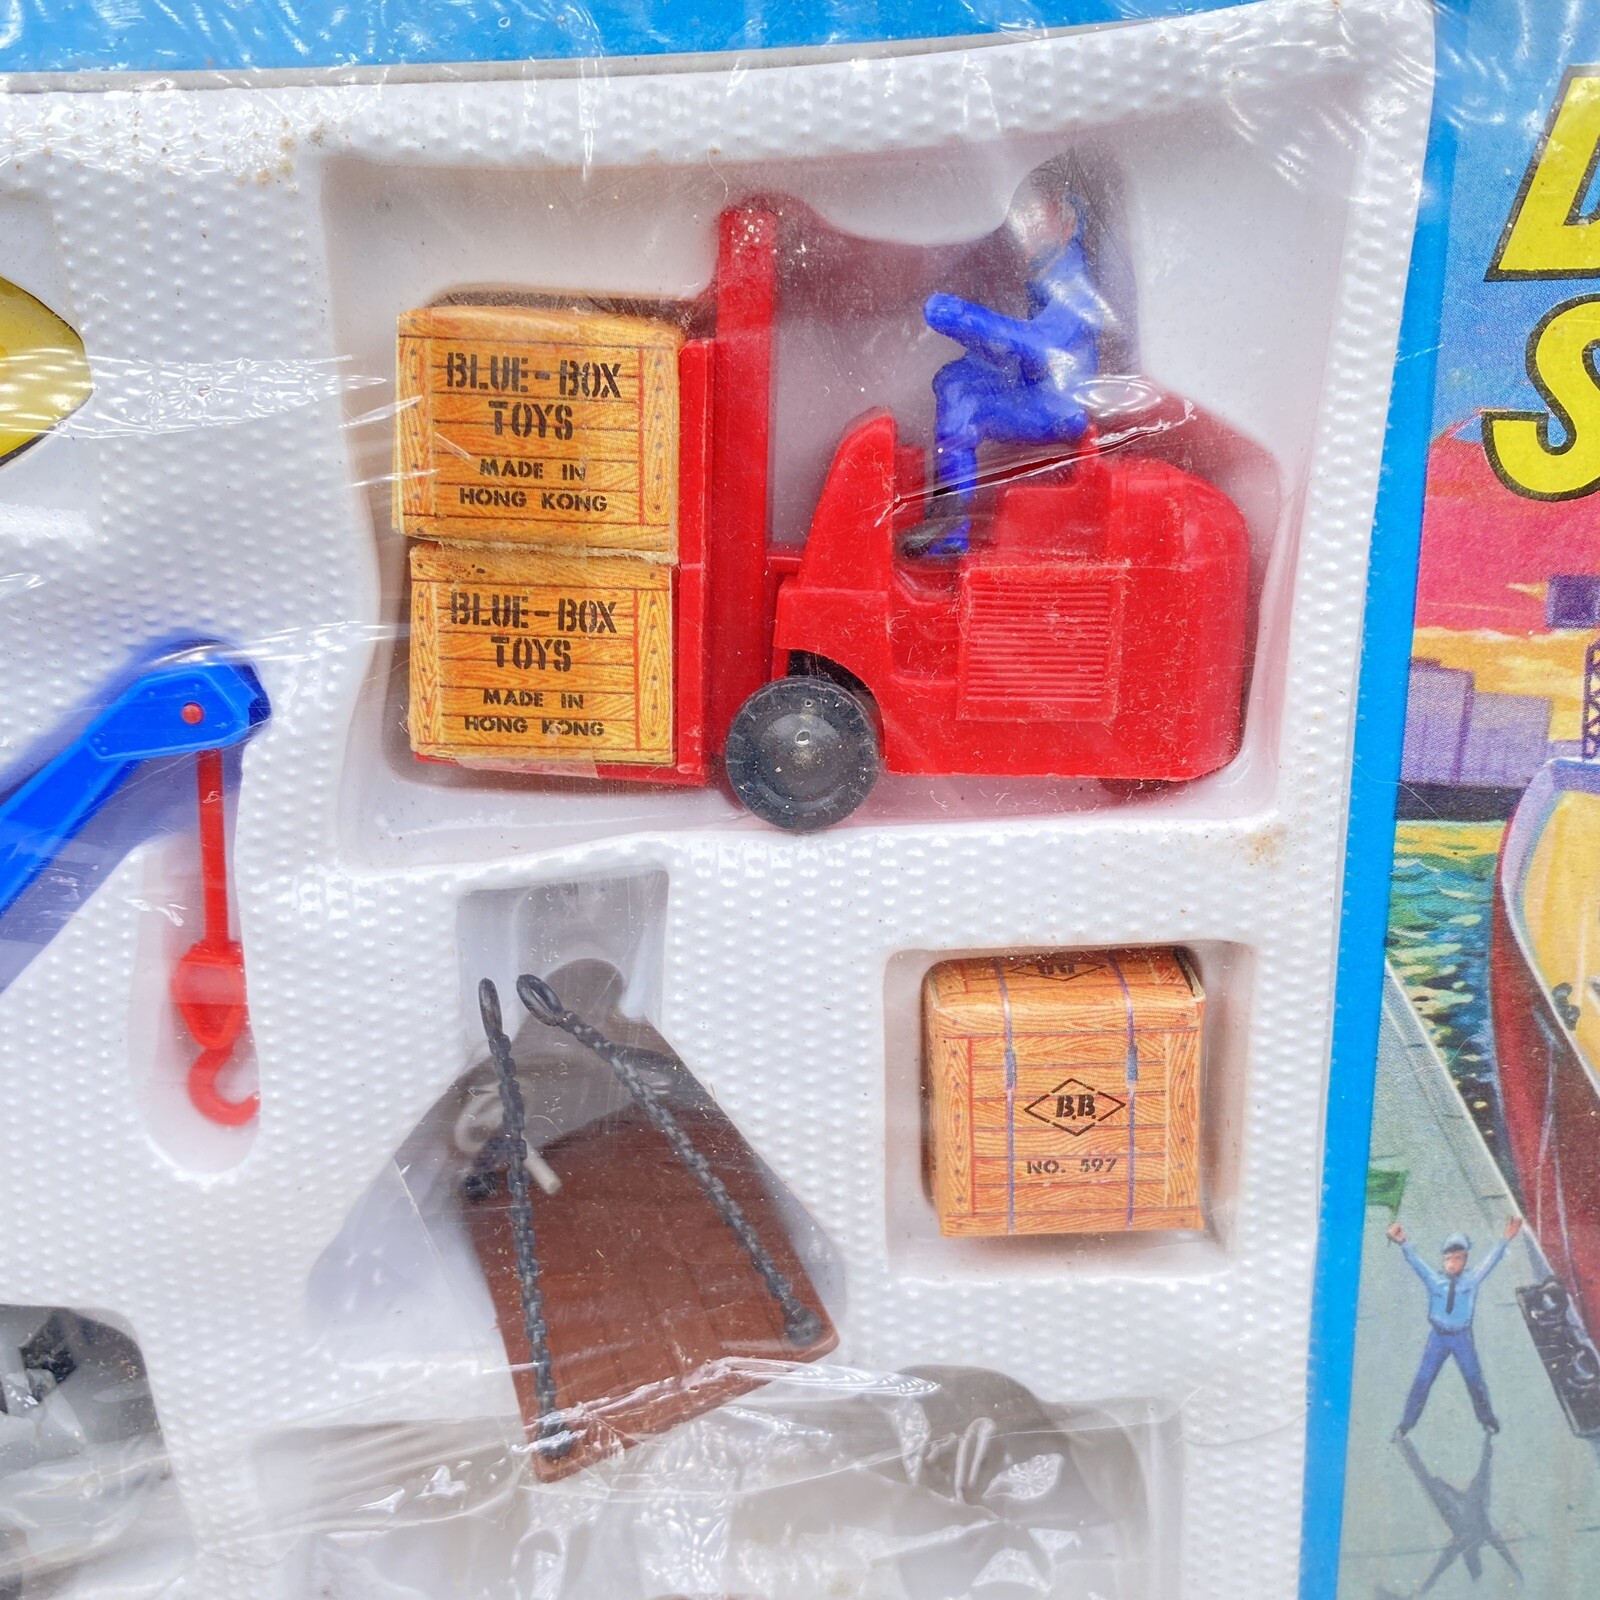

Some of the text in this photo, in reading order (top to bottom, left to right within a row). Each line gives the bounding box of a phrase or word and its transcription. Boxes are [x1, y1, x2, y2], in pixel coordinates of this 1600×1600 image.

[488, 401, 574, 441] TOYS
[479, 458, 586, 482] MADE IN
[459, 487, 608, 512] HONG KONG
[490, 636, 572, 672] TOYS
[483, 688, 584, 710] MADE IN
[464, 717, 605, 737] HONG KONG
[1055, 1094, 1097, 1121] B.B.
[1026, 1157, 1118, 1175] NO. 597
